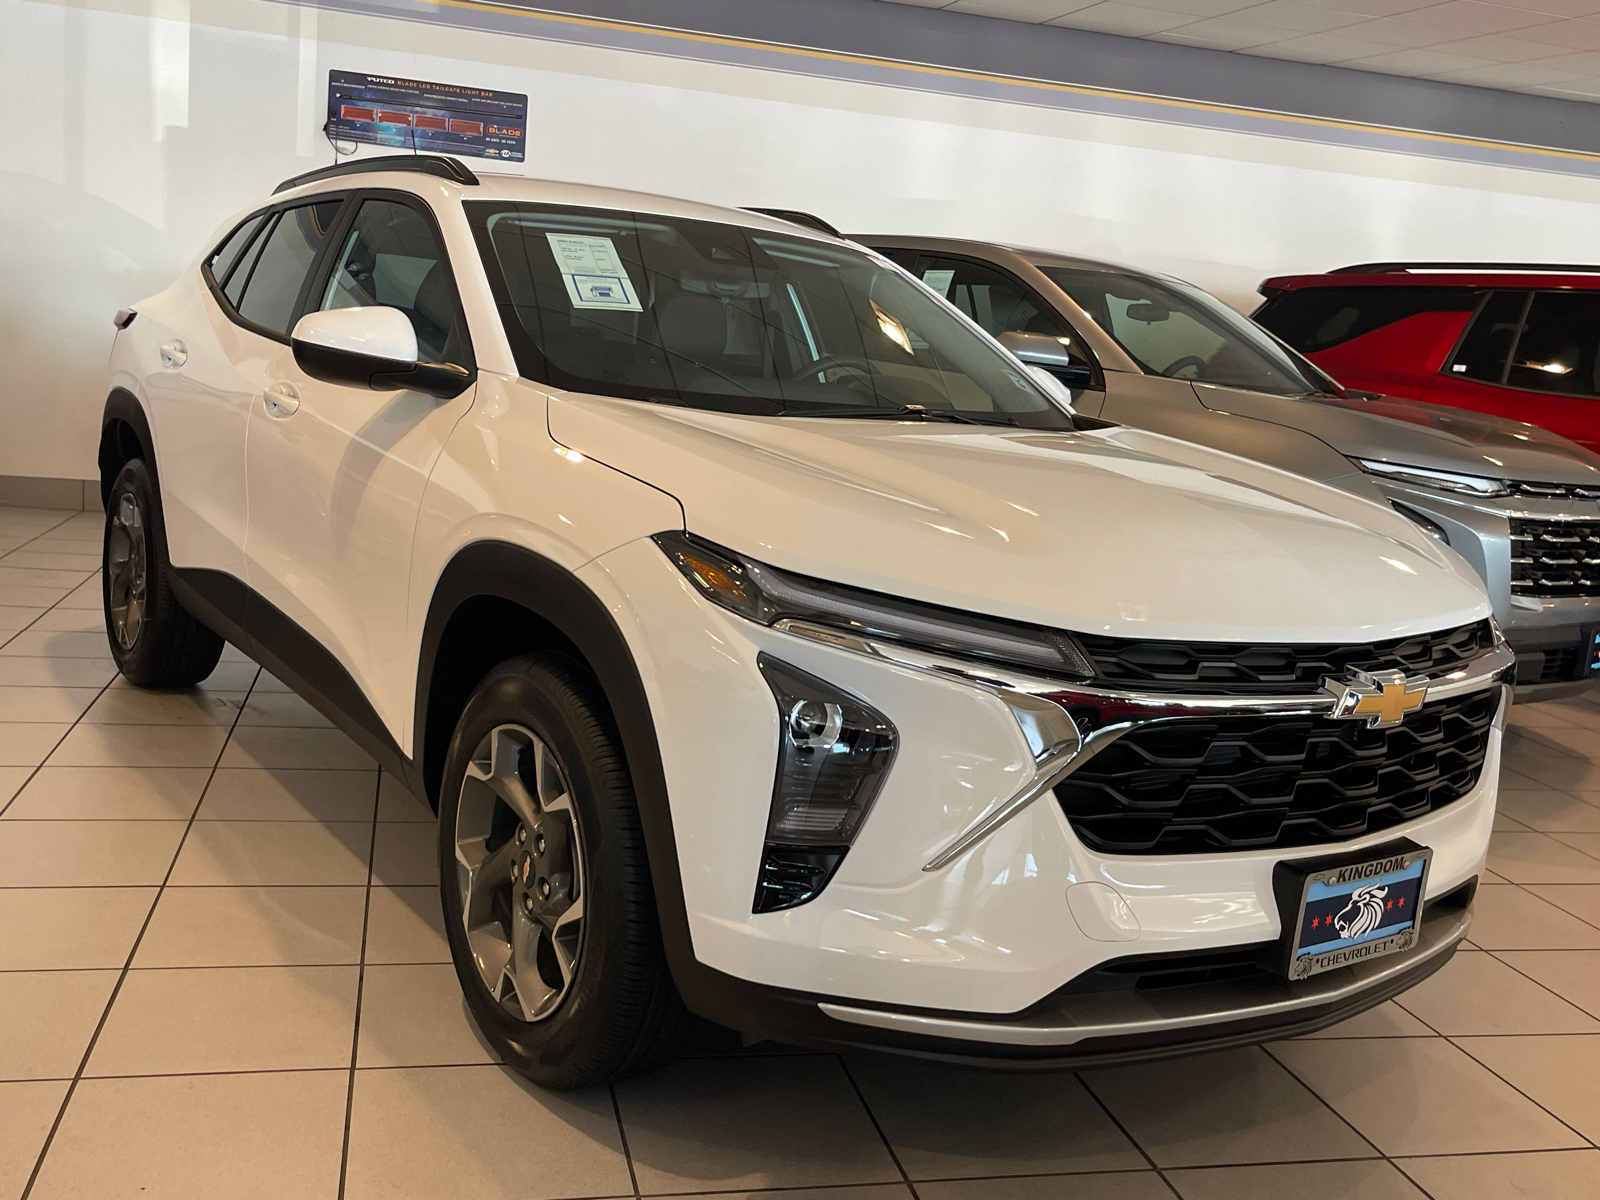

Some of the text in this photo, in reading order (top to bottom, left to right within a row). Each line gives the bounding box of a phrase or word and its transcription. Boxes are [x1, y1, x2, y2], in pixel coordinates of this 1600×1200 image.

[367, 77, 395, 85] PUTCO
[433, 85, 460, 93] TAILGATE
[489, 127, 521, 136] BLADE
[1336, 856, 1404, 884] KINGDOM
[1320, 940, 1389, 968] CHEVROLET
